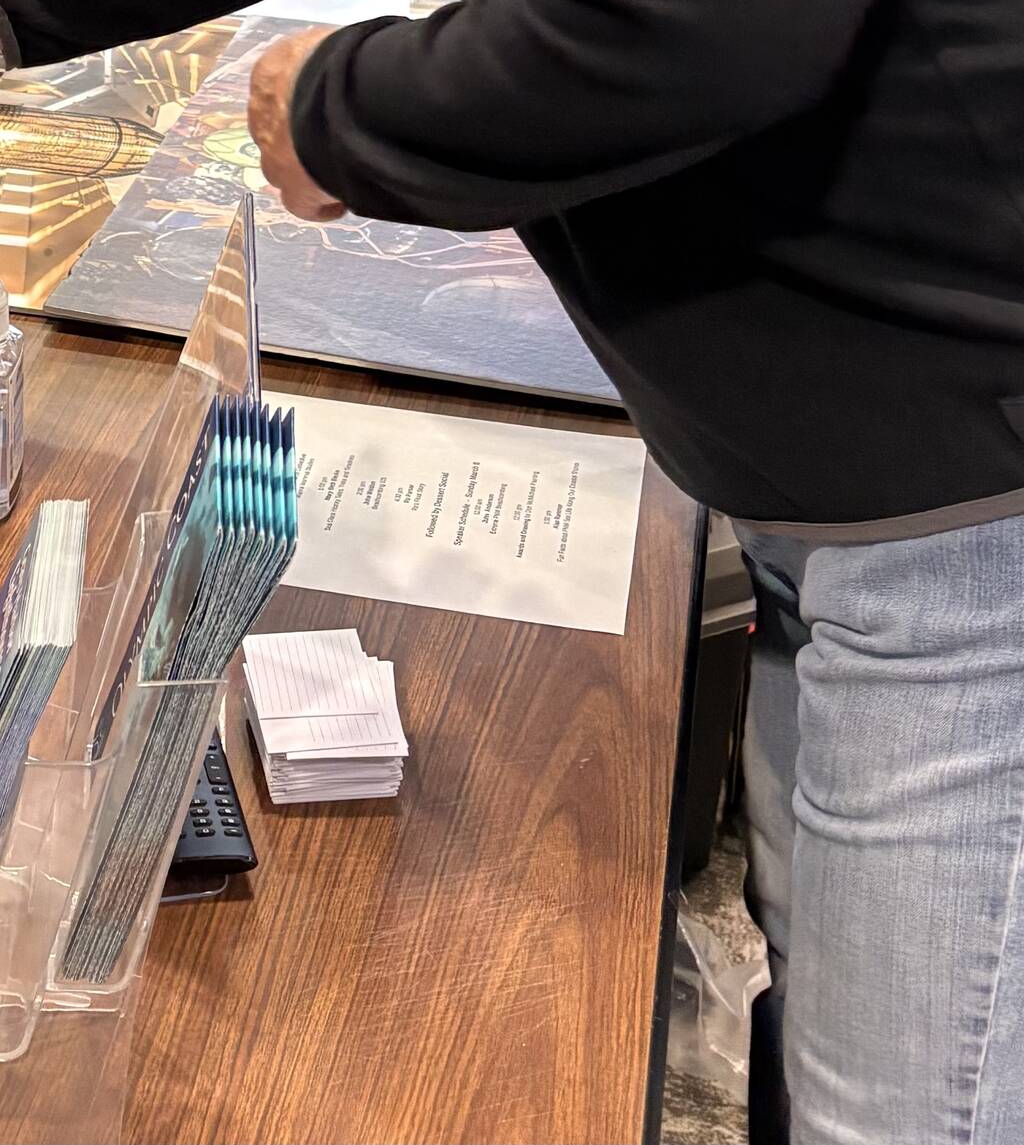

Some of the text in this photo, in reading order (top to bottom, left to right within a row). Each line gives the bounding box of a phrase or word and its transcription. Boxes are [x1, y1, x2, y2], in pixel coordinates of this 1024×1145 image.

[166, 424, 212, 551] COAST
[438, 471, 449, 487] Social
[465, 481, 477, 497] Sunday
[433, 488, 445, 506] Dessert
[458, 503, 470, 524] Schedule
[425, 514, 438, 537] Followed
[453, 525, 466, 545] Speaker
